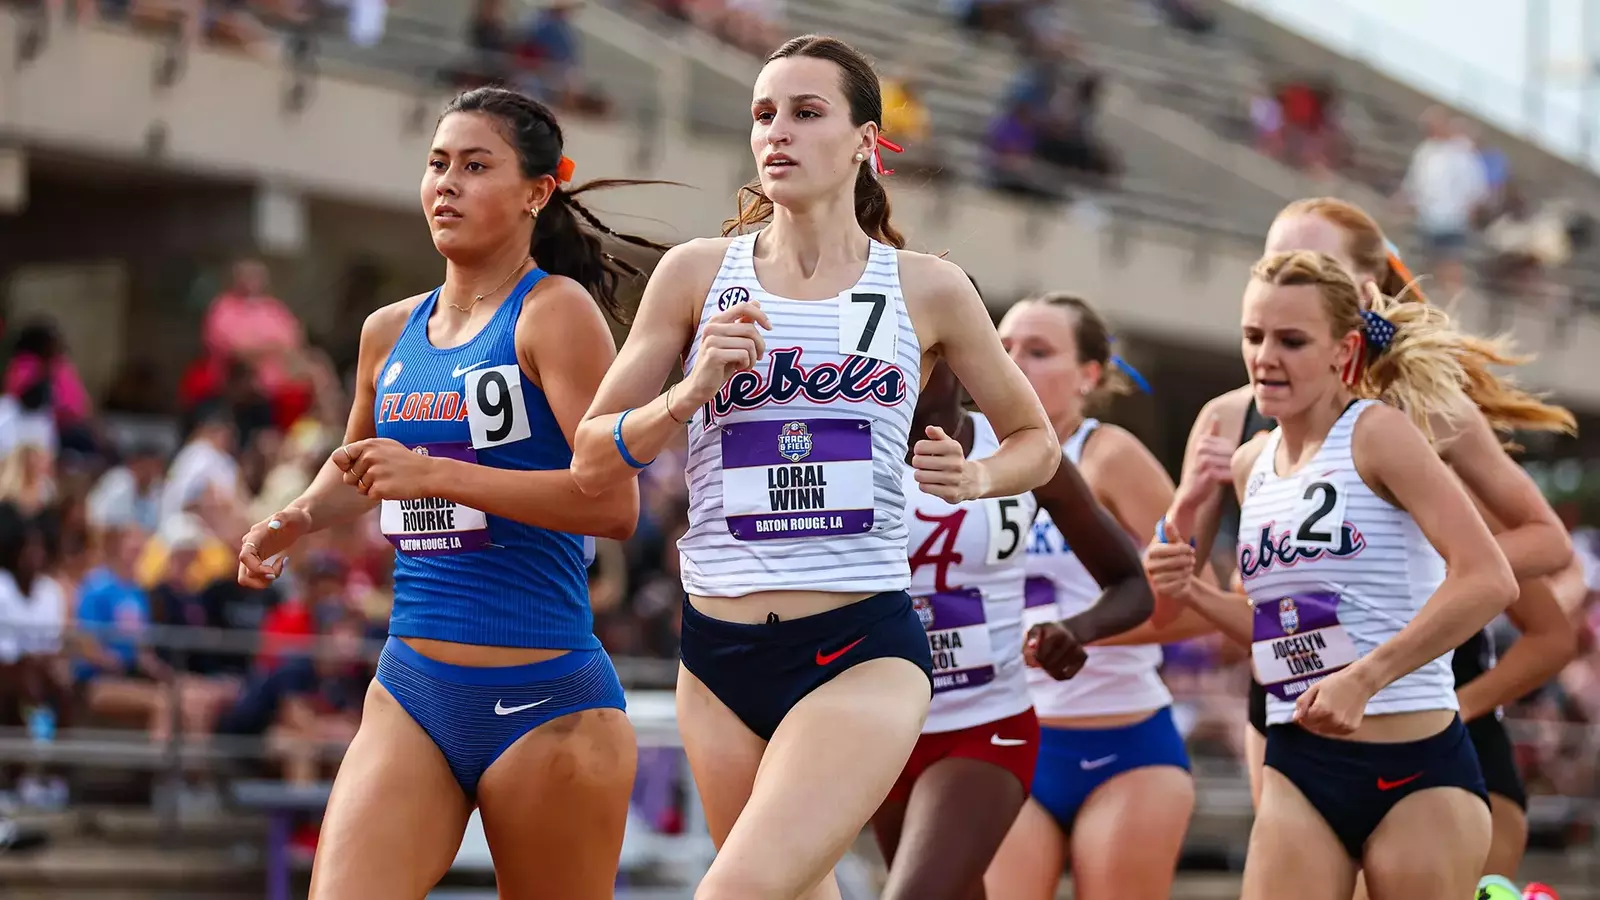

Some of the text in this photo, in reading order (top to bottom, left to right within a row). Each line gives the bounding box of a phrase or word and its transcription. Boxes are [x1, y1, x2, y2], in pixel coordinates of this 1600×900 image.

[851, 293, 886, 352] 7
[477, 371, 513, 442] 9
[780, 435, 810, 444] TRACK
[787, 443, 810, 451] FIELD
[768, 465, 827, 489] LORAL
[769, 487, 825, 511] WINN
[403, 510, 455, 531] ROURKE
[1297, 482, 1337, 542] 2
[755, 516, 843, 533] BATON ROUGE, LA
[997, 499, 1020, 560] 5
[421, 537, 450, 551] ROUGE,
[450, 537, 462, 549] LA
[1272, 631, 1327, 660] JOCELYN
[1286, 653, 1324, 675] LONG
